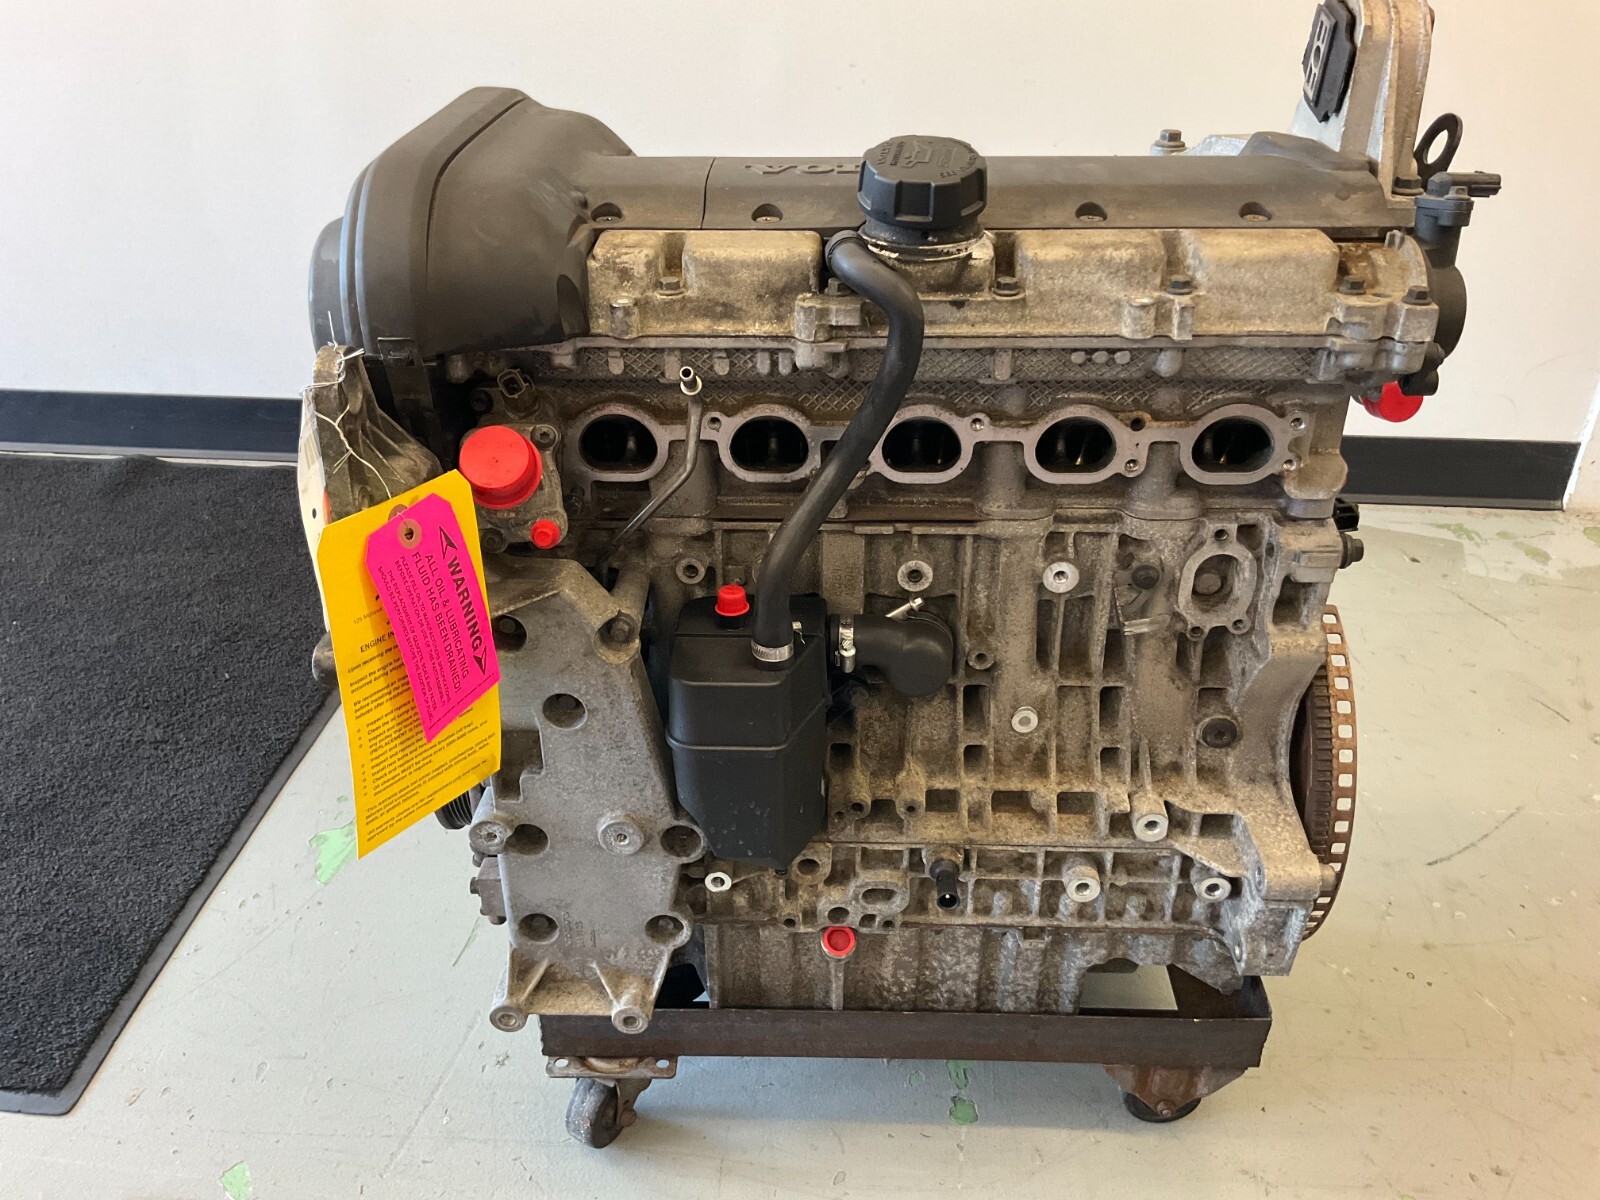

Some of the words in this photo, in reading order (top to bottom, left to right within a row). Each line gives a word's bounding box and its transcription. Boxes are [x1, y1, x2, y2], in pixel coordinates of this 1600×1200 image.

[744, 163, 860, 175] VOL
[394, 559, 408, 584] BEFORE
[425, 554, 439, 577] ALL
[400, 555, 413, 579] PLEASE
[410, 579, 418, 592] FILL
[414, 592, 422, 603] OIL
[418, 602, 425, 611] TO
[434, 577, 447, 598] OIL
[386, 569, 395, 582] THE
[391, 582, 411, 624] REPLACEMENT
[408, 625, 415, 634] OF
[404, 584, 421, 618] OPERATION
[441, 598, 450, 608] &
[446, 554, 484, 652] WARNING
[377, 565, 391, 591] SHOULD
[388, 591, 395, 601] BE
[392, 600, 409, 637] PERFORMED
[405, 637, 416, 659] BEFORE
[416, 672, 427, 697] ADDITION
[411, 551, 430, 586] FLUID
[425, 586, 440, 612] HAS
[434, 612, 449, 643] BEEN
[443, 643, 462, 693] DRAINED!
[417, 618, 424, 628] OR
[420, 628, 428, 640] USE
[360, 634, 387, 653] ENGINE
[424, 640, 430, 648] OF
[444, 608, 470, 679] LUBRICATING
